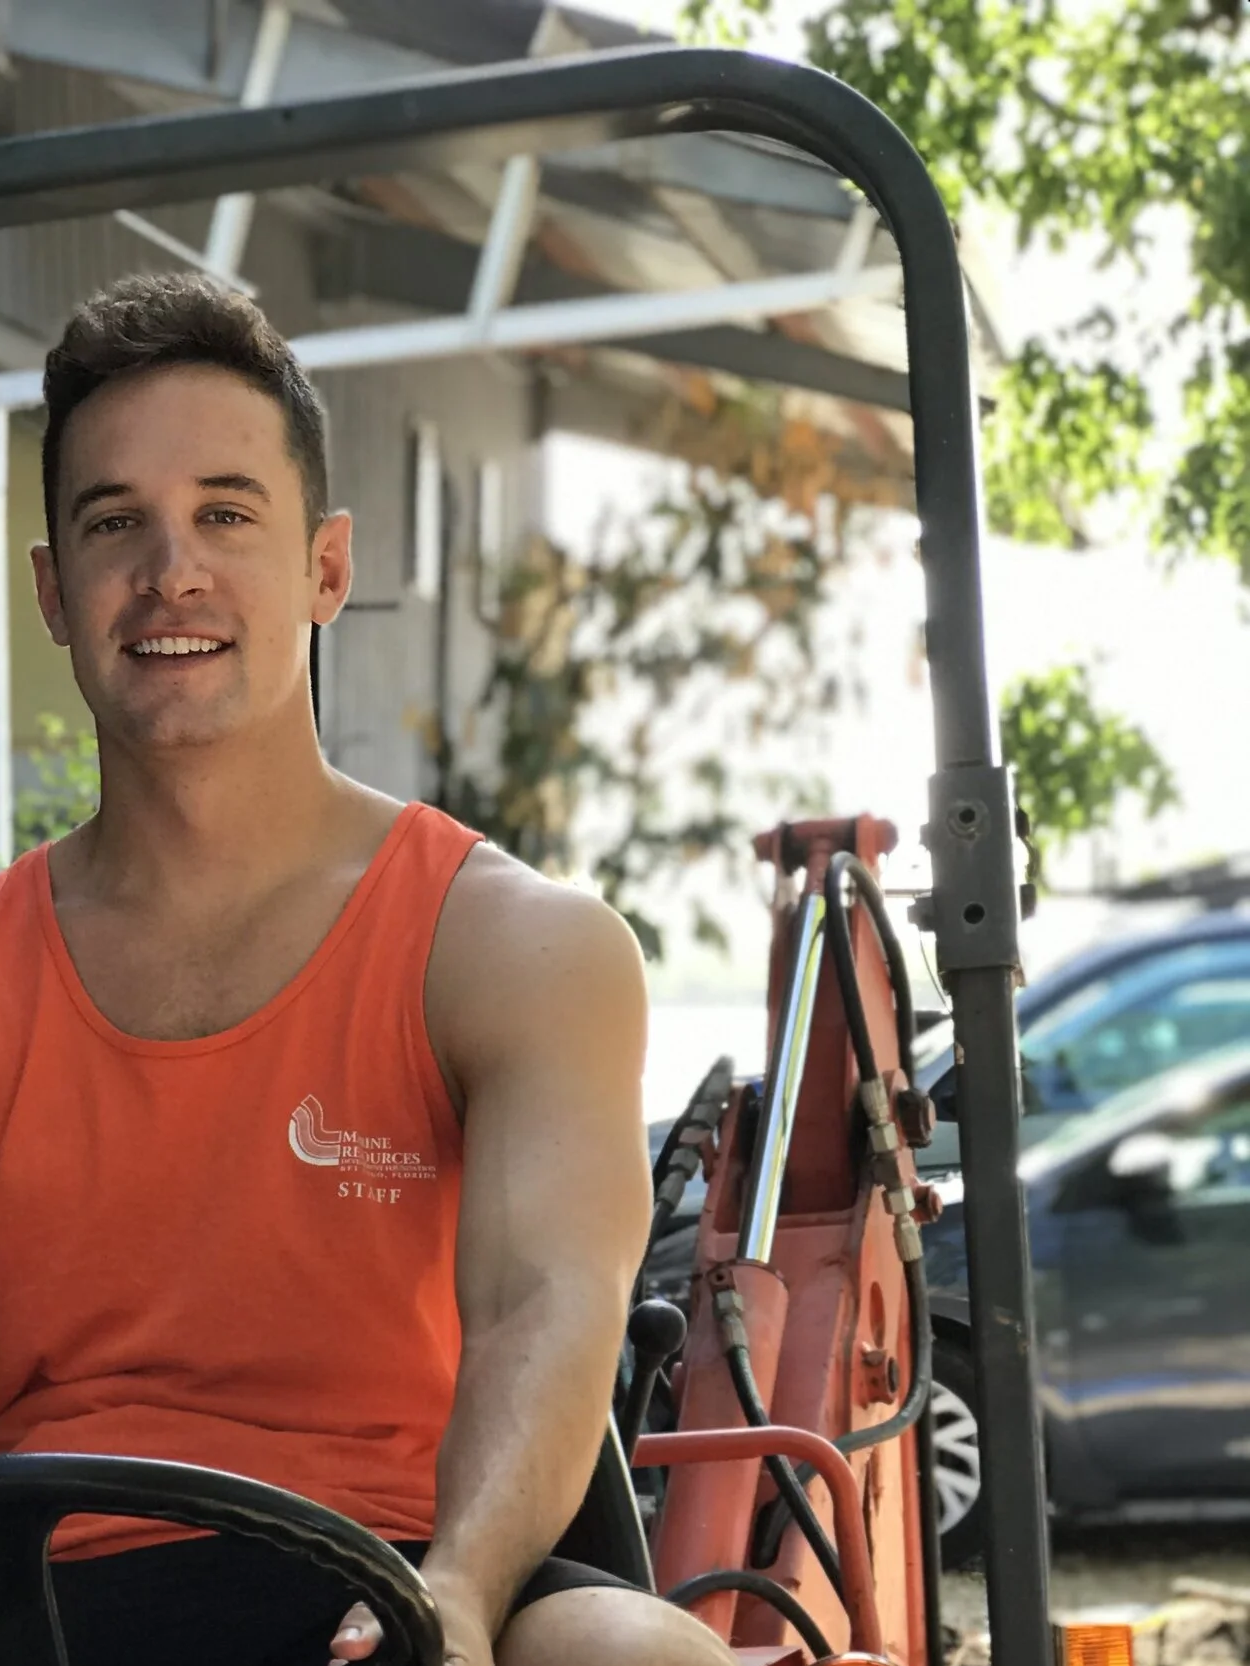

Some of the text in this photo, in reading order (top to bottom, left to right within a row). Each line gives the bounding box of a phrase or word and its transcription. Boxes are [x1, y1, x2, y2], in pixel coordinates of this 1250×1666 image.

[343, 1131, 392, 1149] MINE
[342, 1146, 421, 1165] REOURCES
[338, 1182, 402, 1204] STAFF
